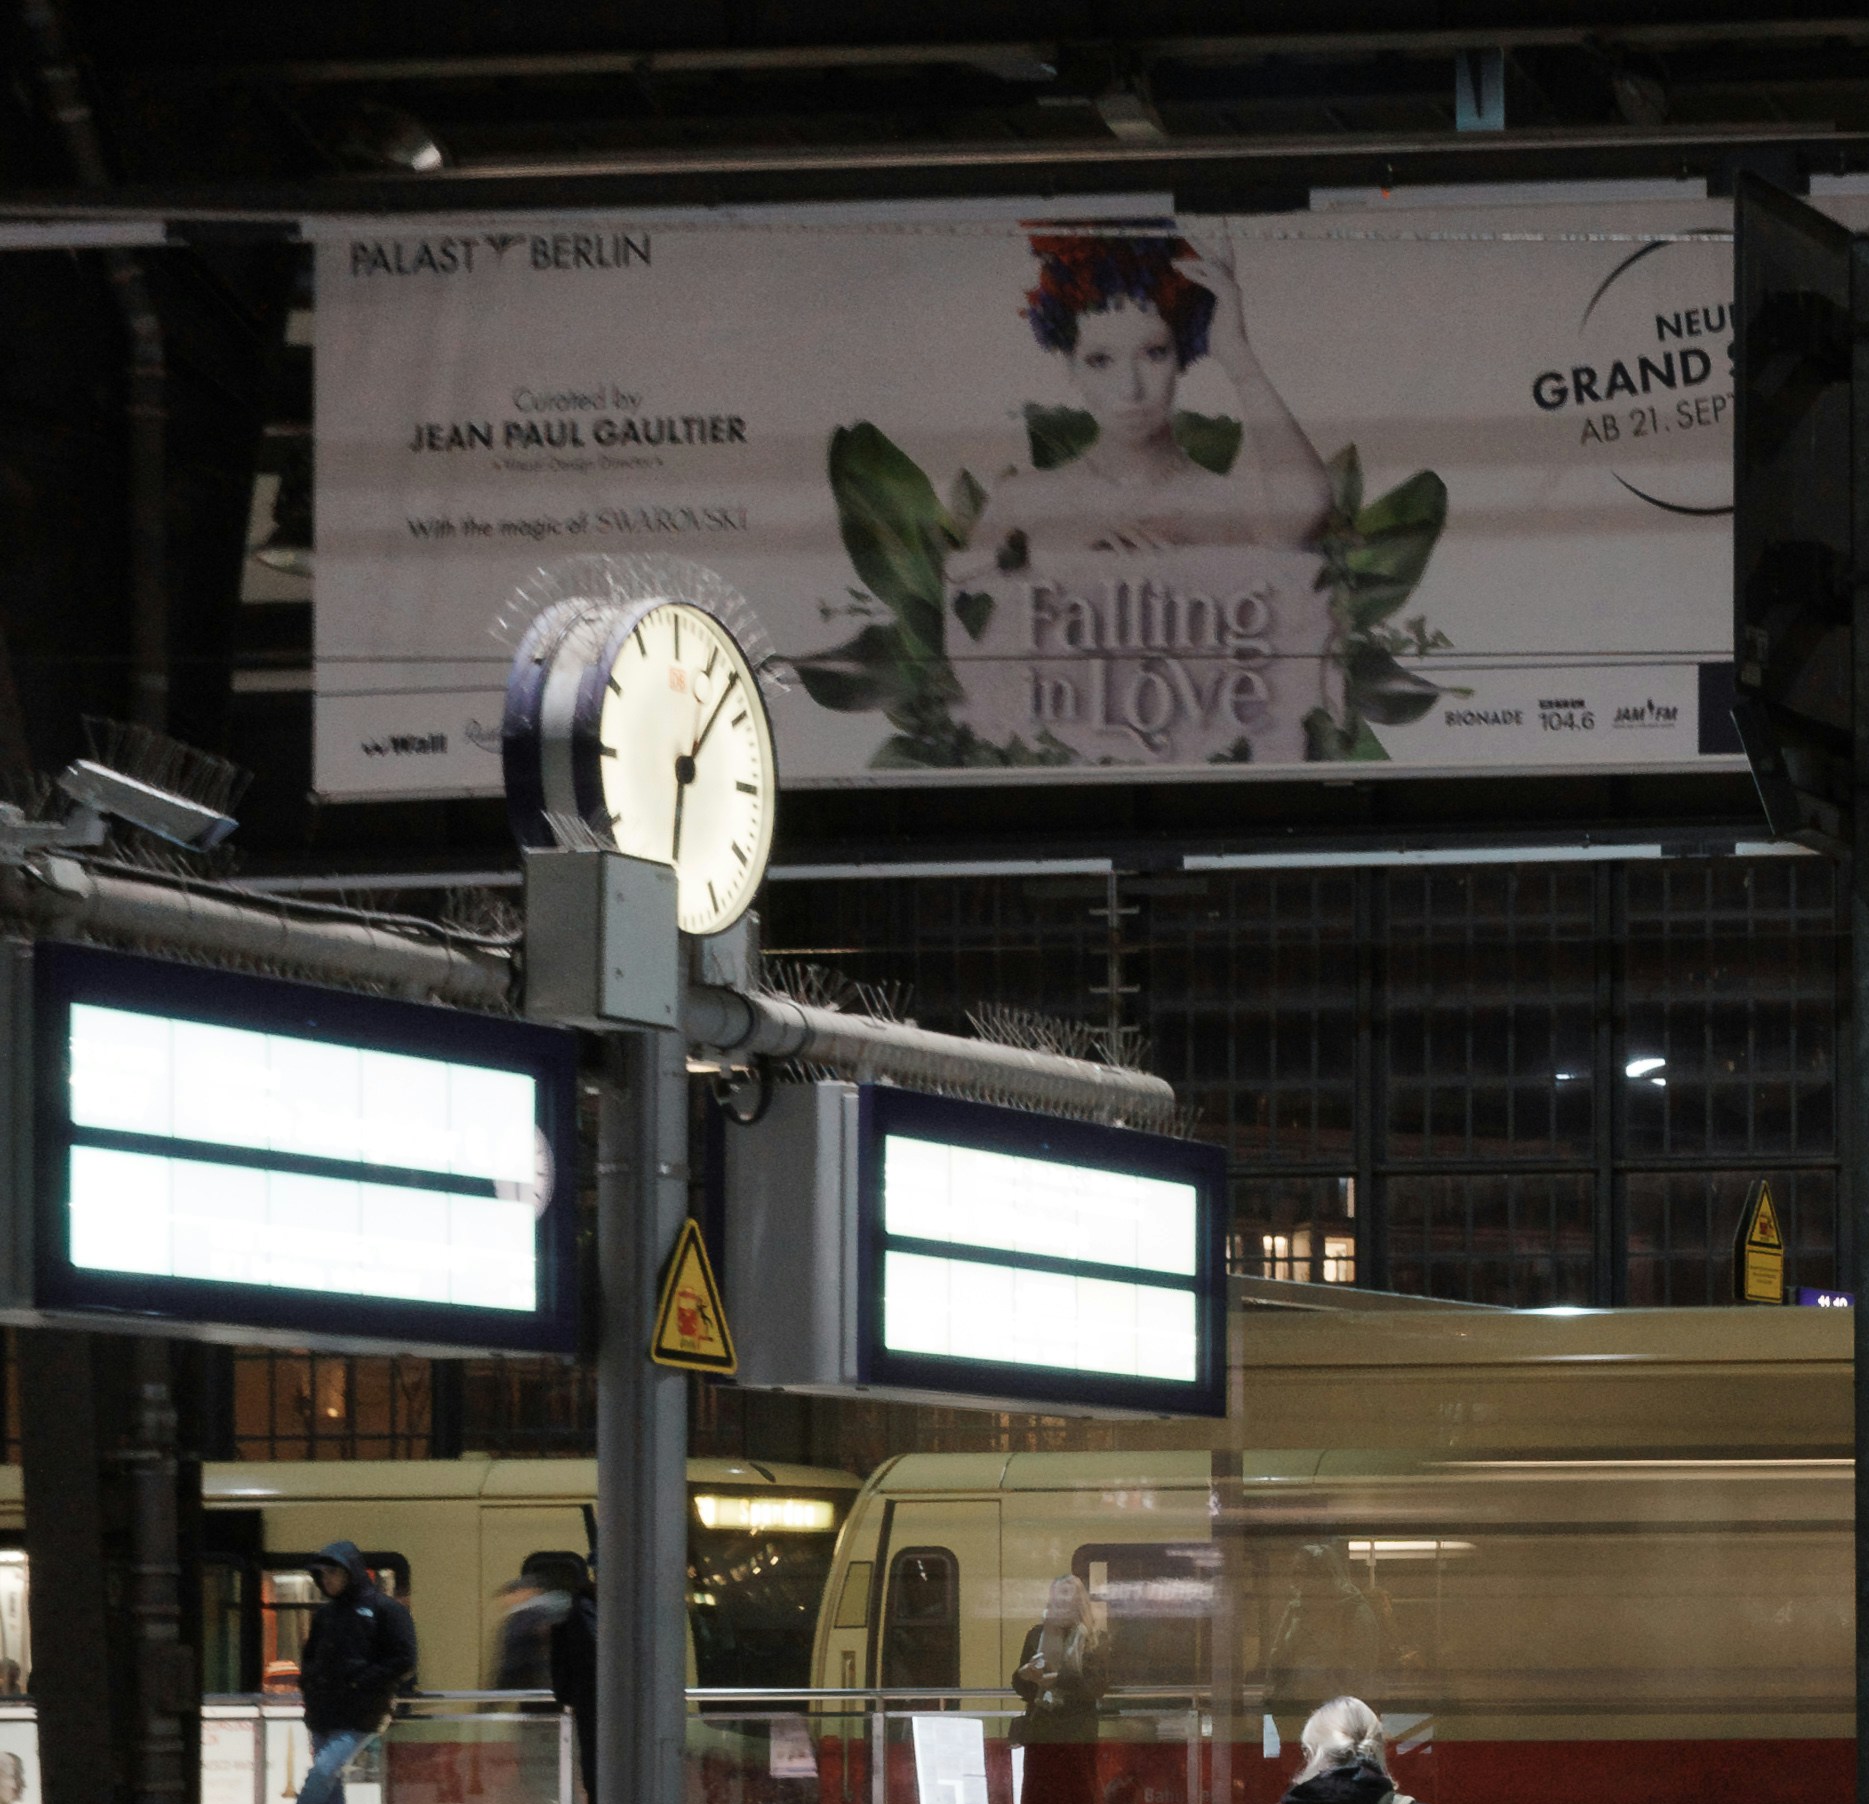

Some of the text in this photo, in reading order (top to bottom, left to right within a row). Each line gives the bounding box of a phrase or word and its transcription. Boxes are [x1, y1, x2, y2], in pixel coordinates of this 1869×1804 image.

[351, 233, 650, 277] PALAST BERLIN
[514, 384, 643, 415] Curated by
[1532, 349, 1712, 411] GRAND
[409, 415, 747, 453] JEAN PAUL GAULTIER
[1581, 393, 1734, 445] AB 21. SEP
[407, 515, 456, 540] With
[460, 513, 493, 538] the
[500, 515, 562, 542] magic
[565, 511, 589, 536] of
[1024, 578, 1275, 670] Falling
[1090, 656, 1272, 753] Love
[1445, 709, 1523, 727] BIONADE
[1538, 710, 1595, 731] 104.6
